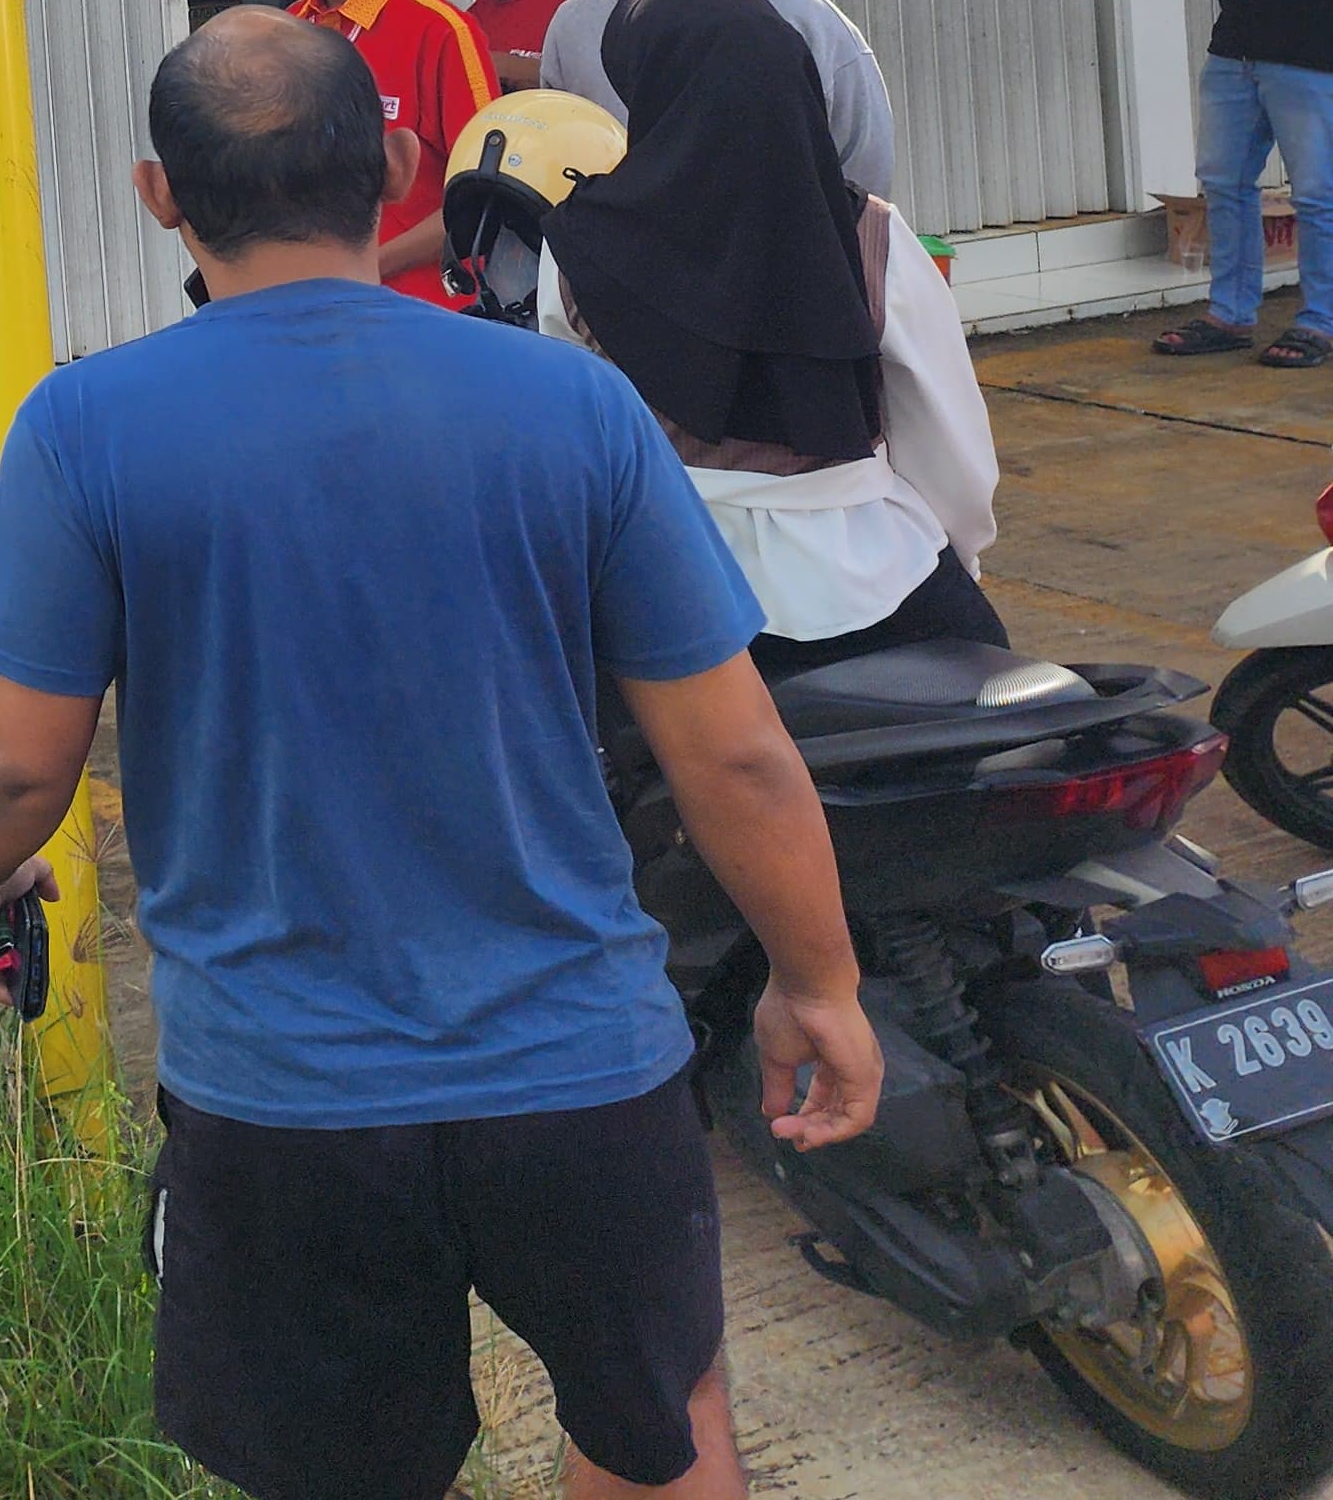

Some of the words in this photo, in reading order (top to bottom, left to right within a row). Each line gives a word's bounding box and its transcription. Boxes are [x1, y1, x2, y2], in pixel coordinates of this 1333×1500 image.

[1216, 975, 1277, 999] HONDA
[1165, 1036, 1218, 1094] K
[1216, 998, 1333, 1077] 2639
